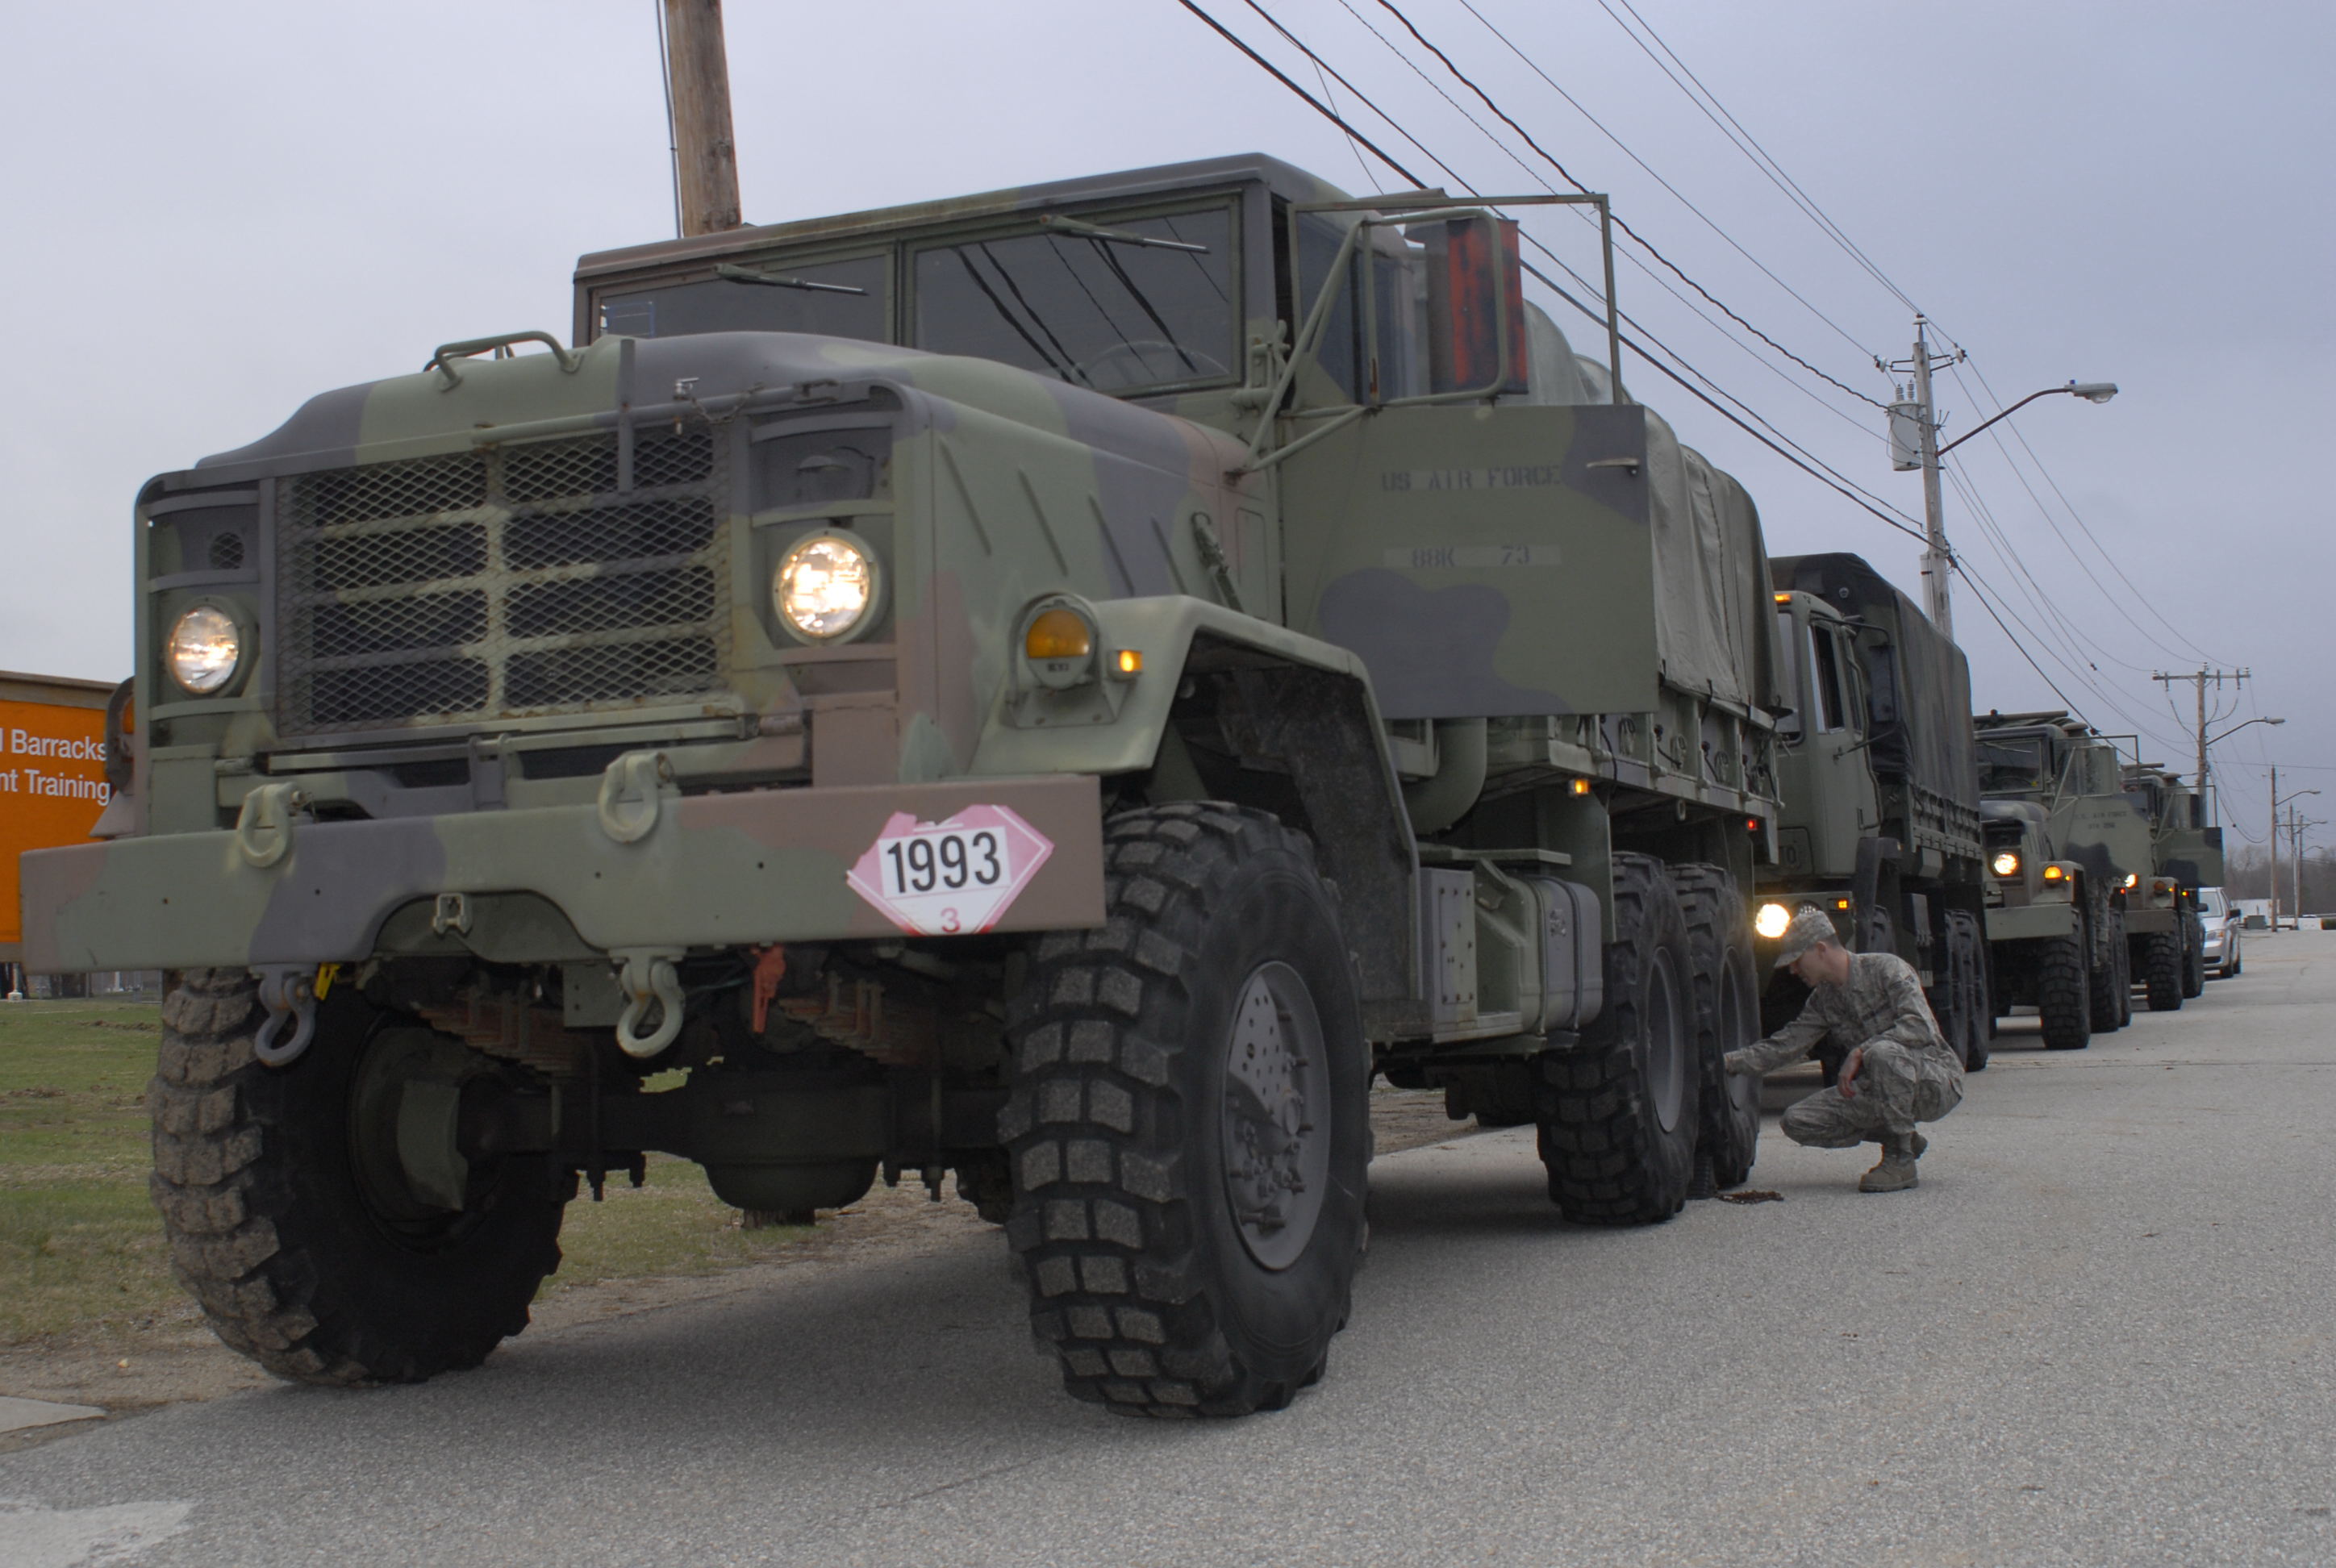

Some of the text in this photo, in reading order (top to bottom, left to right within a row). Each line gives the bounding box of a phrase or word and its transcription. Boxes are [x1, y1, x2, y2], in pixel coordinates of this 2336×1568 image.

[1381, 464, 1562, 492] US AIR FORCE
[11, 728, 107, 761] Barracks
[24, 769, 111, 807] Training
[887, 831, 1001, 894] 1993
[940, 907, 962, 934] 3
